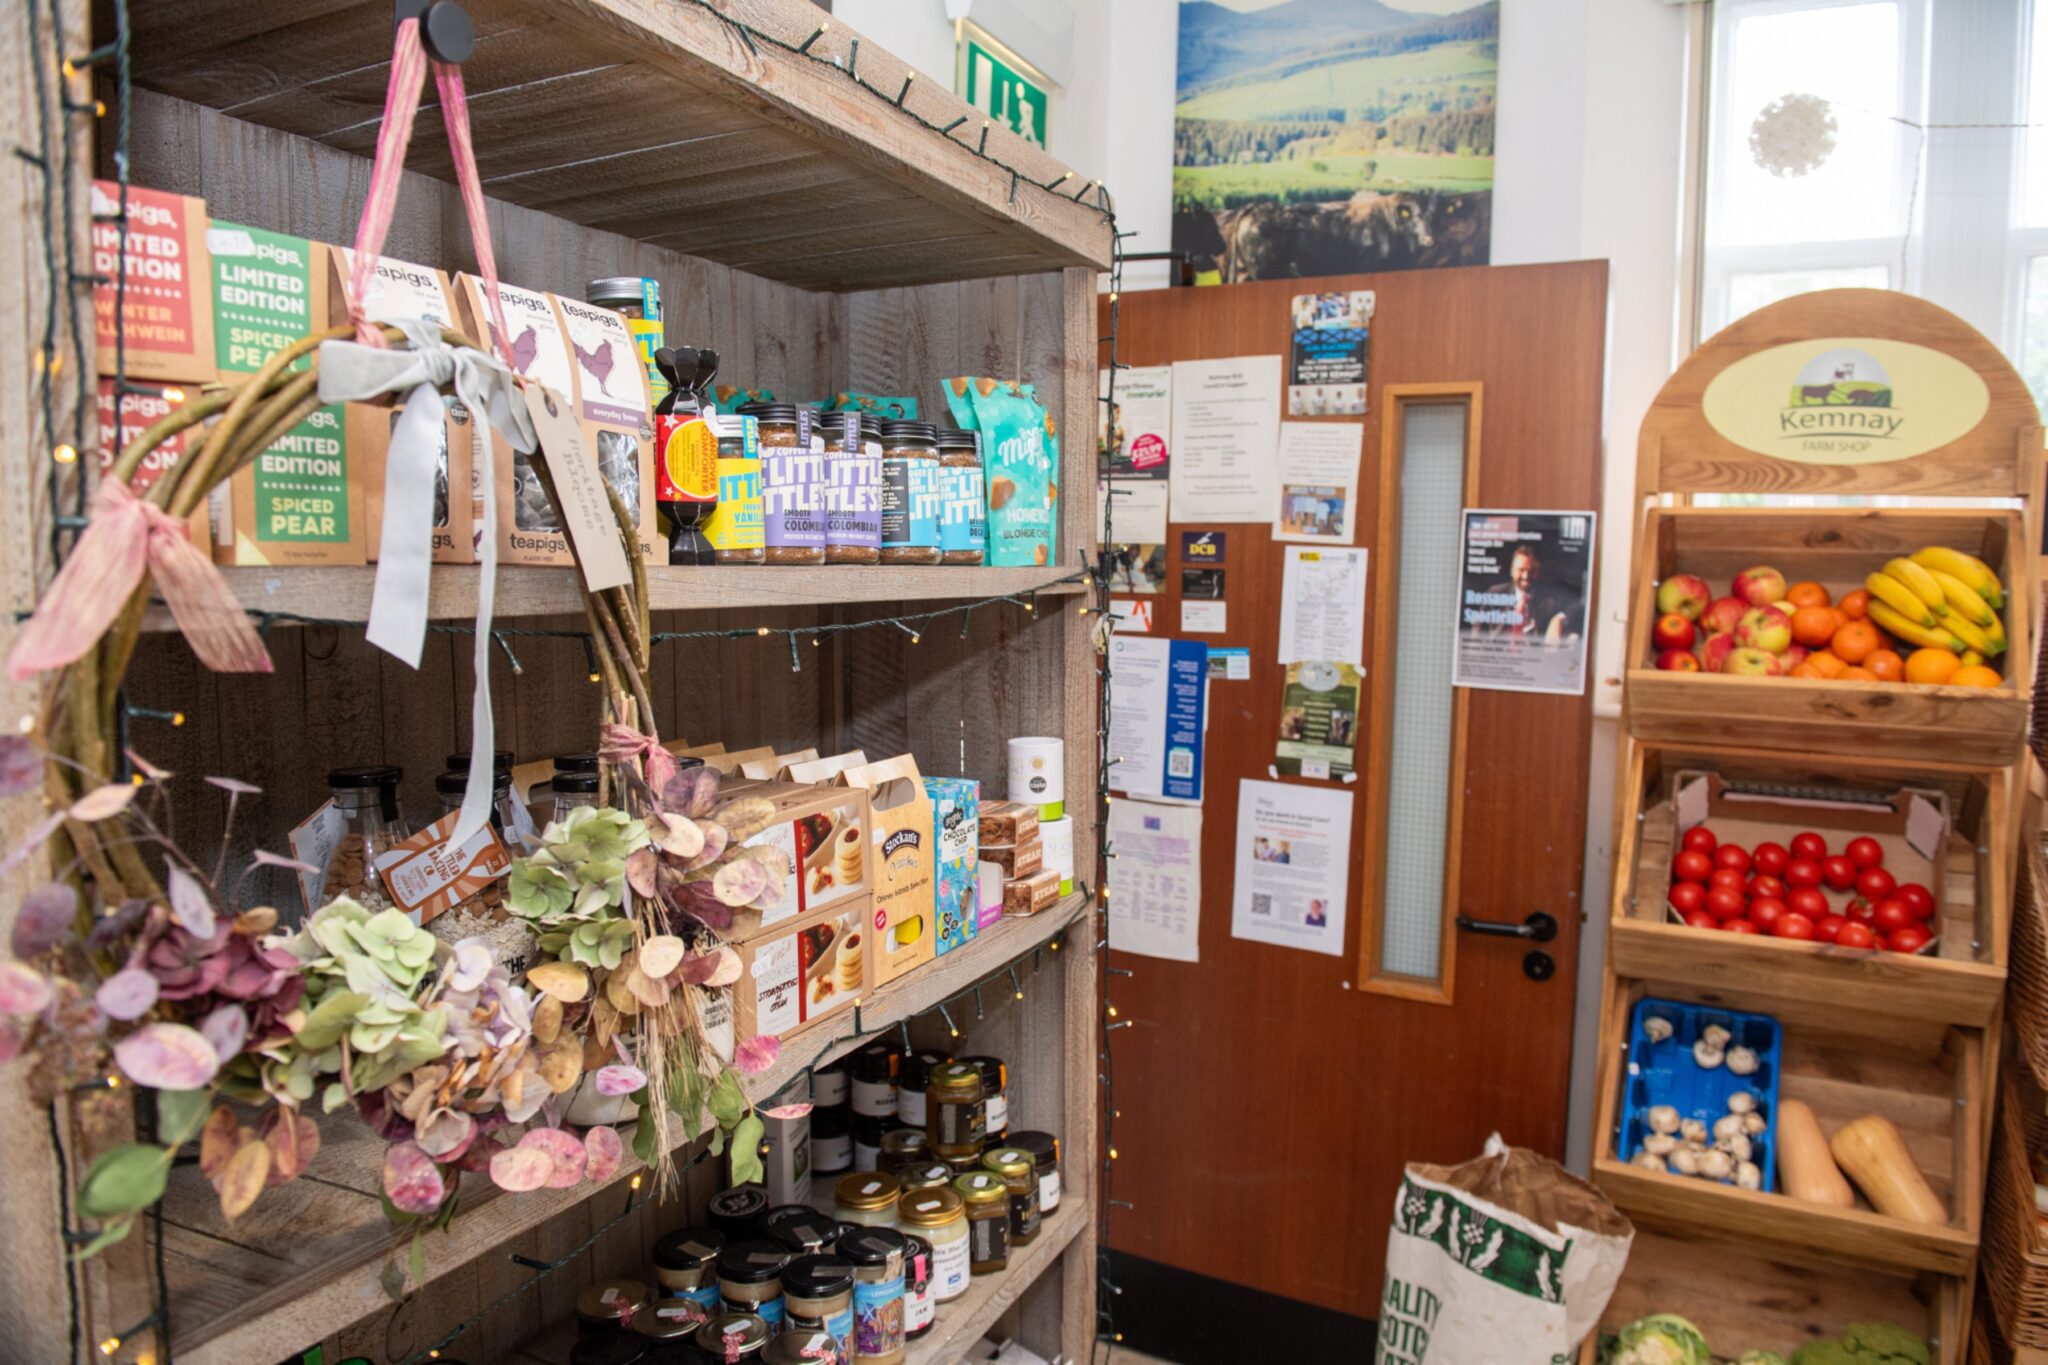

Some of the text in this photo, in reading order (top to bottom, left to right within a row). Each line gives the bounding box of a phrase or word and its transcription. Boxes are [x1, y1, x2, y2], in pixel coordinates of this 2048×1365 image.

[93, 226, 180, 258] IMITED
[95, 251, 182, 282] DITION
[220, 262, 304, 294] LIMITED
[220, 284, 305, 316] EDITION
[480, 281, 551, 315] tapigs.
[95, 300, 172, 322] WNTER
[593, 408, 638, 423] everyday brew
[1780, 409, 1904, 436] Kemnay
[1802, 440, 1872, 453] FARM SHOP
[261, 455, 341, 477] EDITION
[701, 425, 709, 492] COMFORTER
[709, 430, 717, 490] ANGOVER
[271, 496, 334, 514] SPICED
[784, 509, 811, 518] SMOOTH
[828, 509, 855, 518] SMOOTH
[271, 513, 336, 536] PEAR
[828, 520, 878, 533] COLOMBIAN
[509, 533, 568, 553] teapigs.
[1189, 543, 1217, 556] DCB
[884, 830, 918, 855] Stockan's
[944, 823, 976, 842] CHOCOLATE
[954, 832, 967, 847] CHIP
[428, 850, 450, 881] BAKING
[1017, 848, 1043, 867] STEAK
[1034, 881, 1060, 901] STEAK
[1388, 1278, 1443, 1332] ALITY
